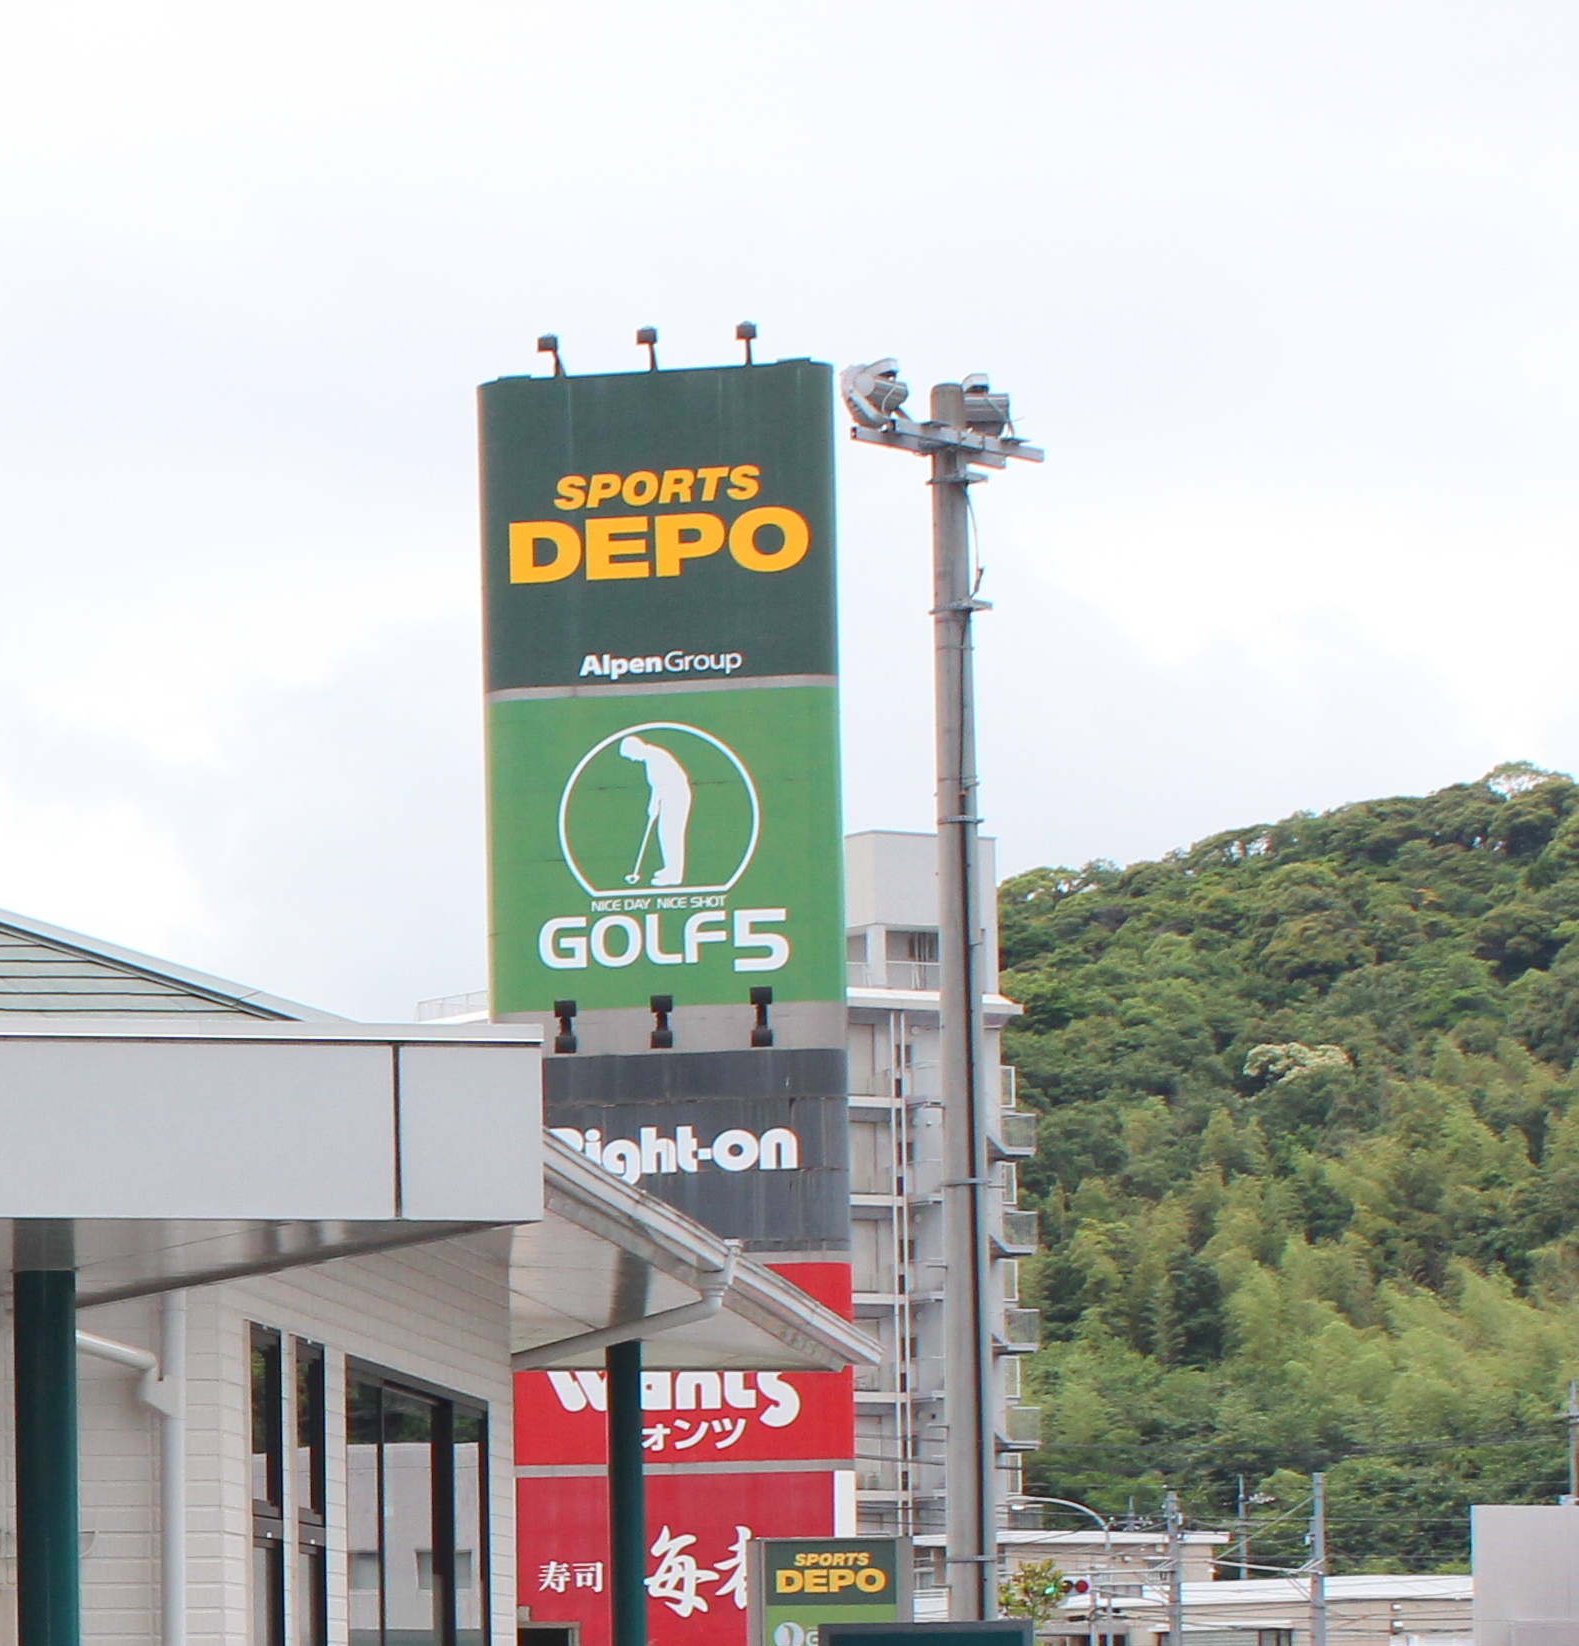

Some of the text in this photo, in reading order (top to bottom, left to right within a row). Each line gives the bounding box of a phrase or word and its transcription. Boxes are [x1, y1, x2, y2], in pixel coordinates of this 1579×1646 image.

[554, 464, 760, 510] SPORTS
[508, 506, 810, 584] DEPO
[591, 894, 727, 912] NICE DAY NICE SHOT
[538, 908, 790, 973] GOLF5
[794, 1552, 870, 1567] SPORTS
[538, 1560, 604, 1593] 寿司
[775, 1567, 887, 1595] DEPO
